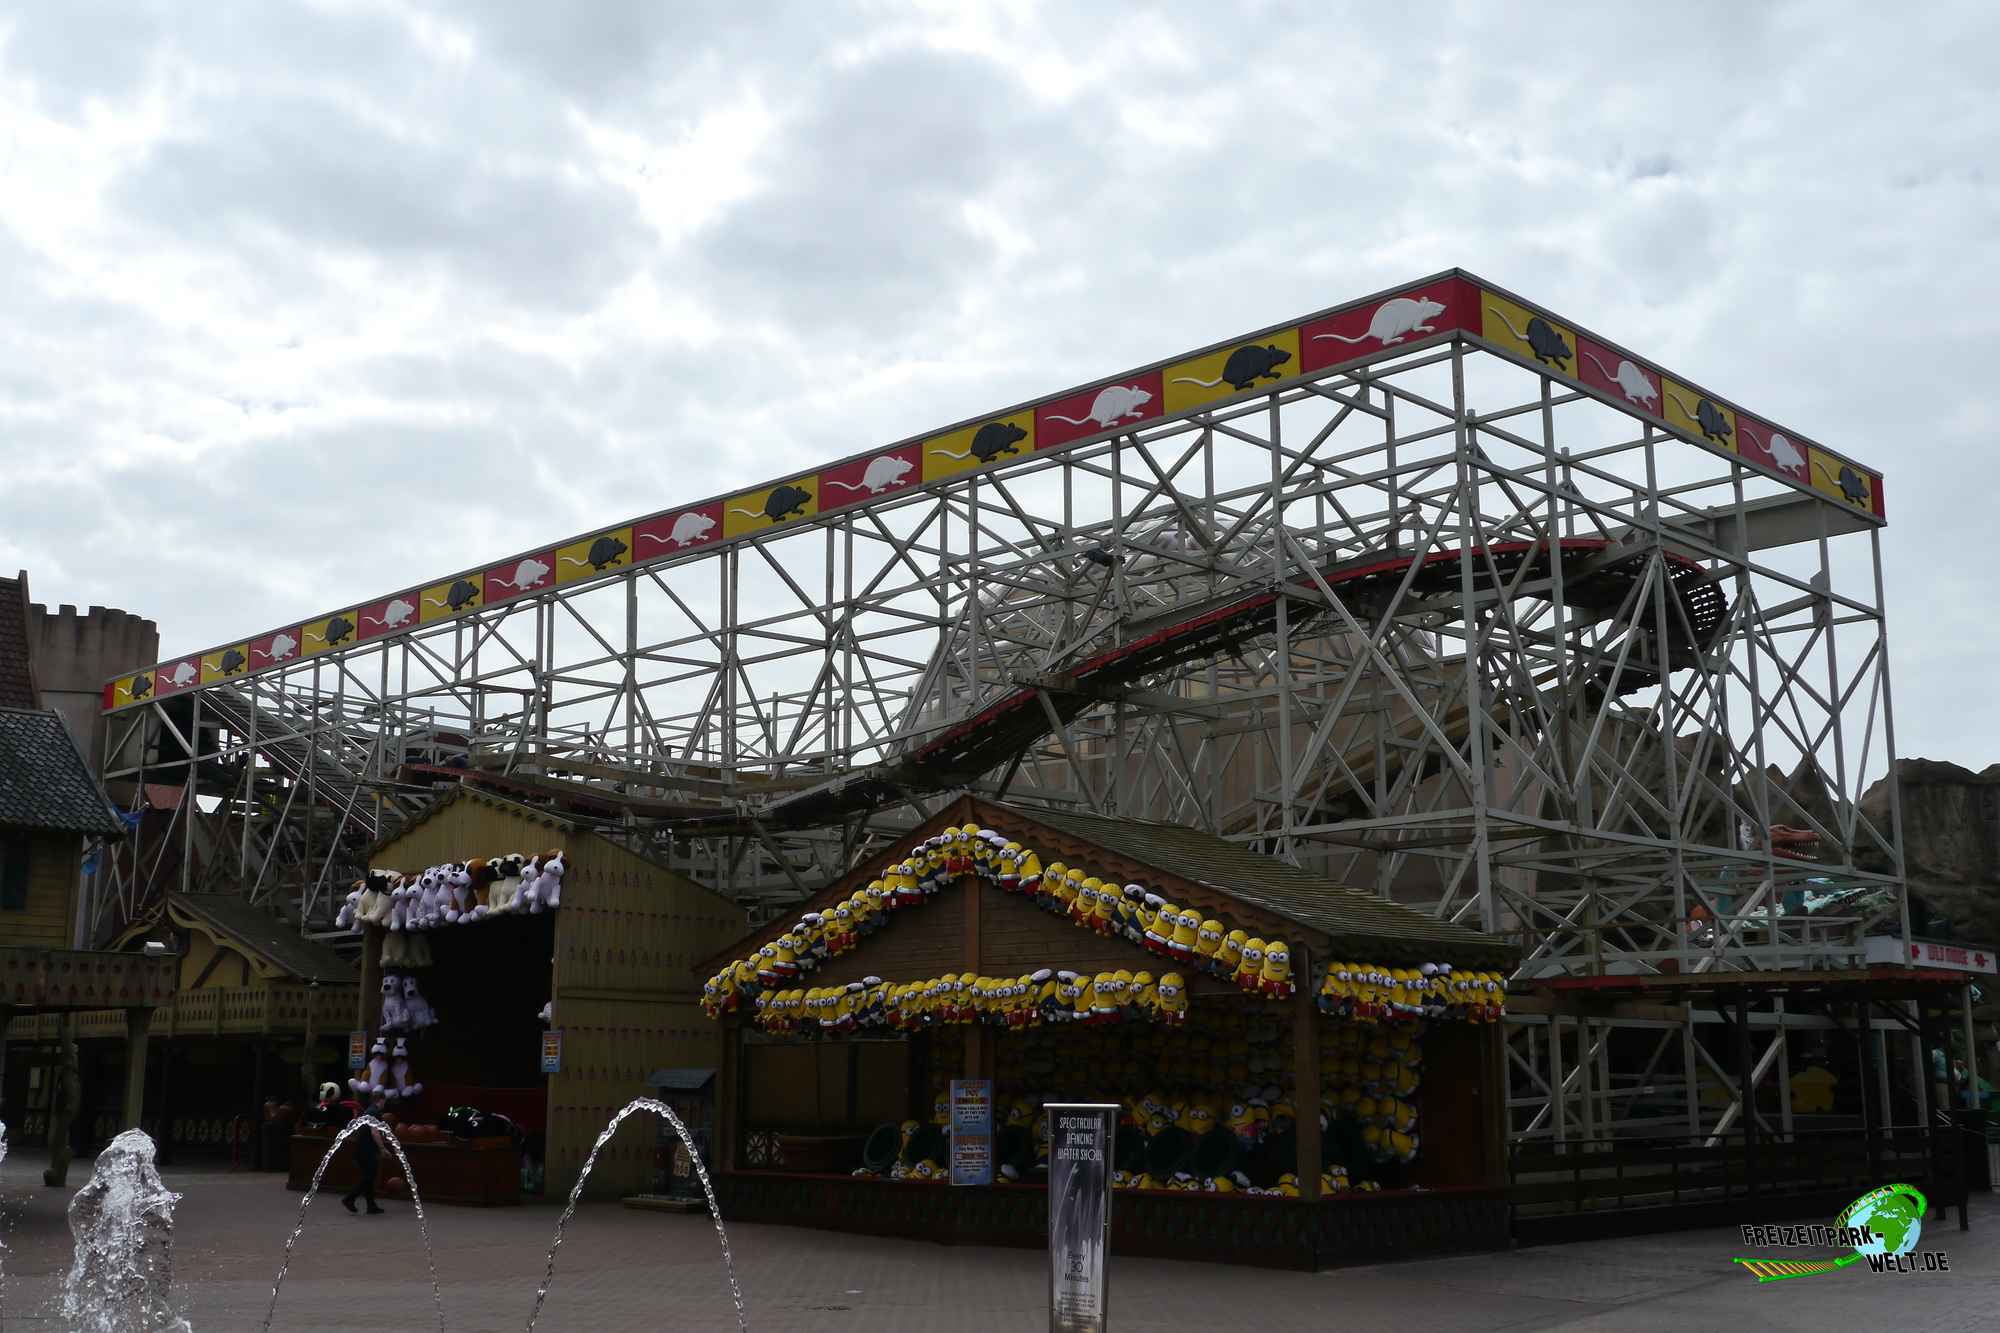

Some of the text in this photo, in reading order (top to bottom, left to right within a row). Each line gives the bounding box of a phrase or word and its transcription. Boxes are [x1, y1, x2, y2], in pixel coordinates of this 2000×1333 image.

[1059, 1117, 1102, 1129] SPECTACULAR
[1066, 1132, 1094, 1145] DANCING
[1057, 1147, 1103, 1161] WATER SHOW
[1068, 1250, 1086, 1262] Every
[1070, 1260, 1083, 1273] 30
